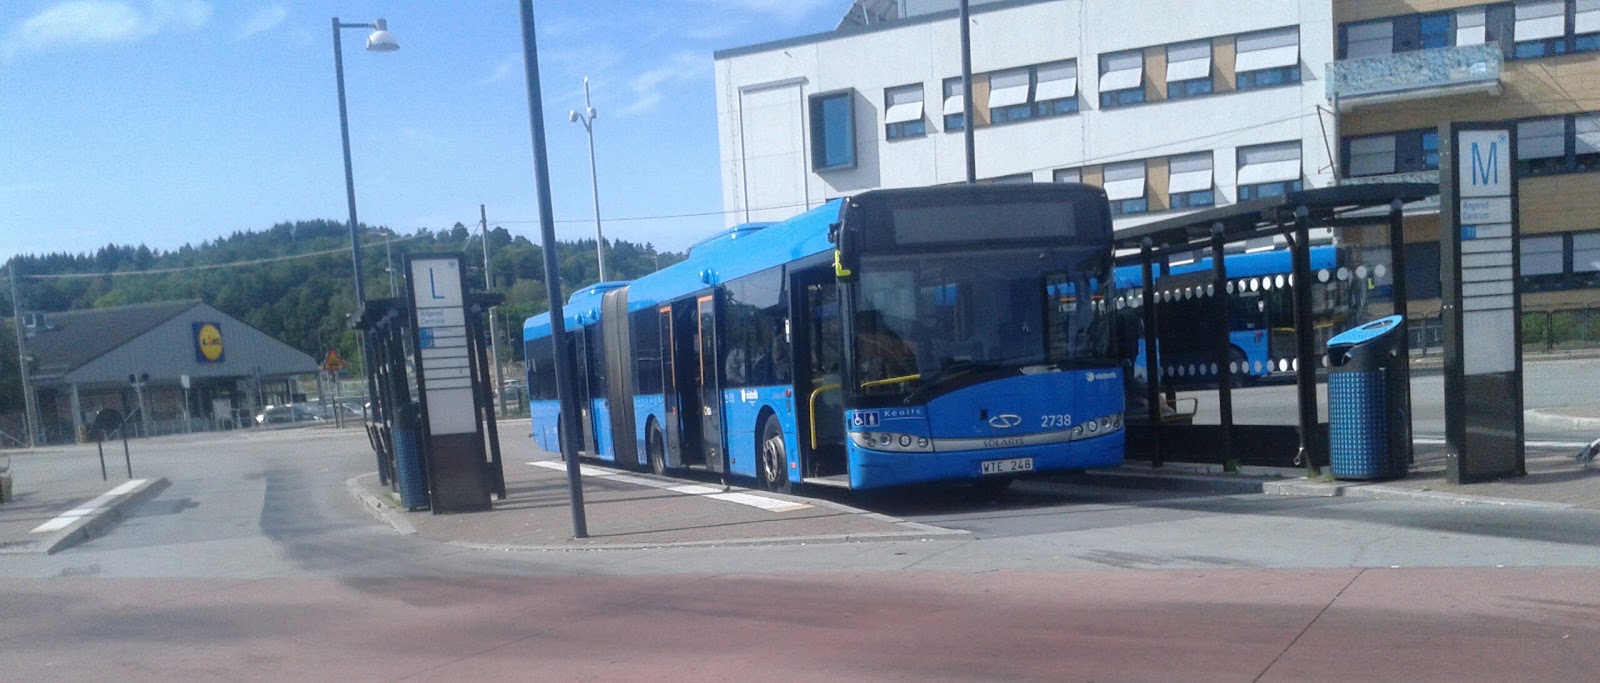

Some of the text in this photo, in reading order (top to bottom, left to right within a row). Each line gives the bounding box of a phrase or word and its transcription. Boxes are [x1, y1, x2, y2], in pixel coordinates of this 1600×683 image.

[1471, 141, 1498, 186] M
[429, 267, 445, 299] L
[1041, 414, 1072, 428] 2738
[983, 438, 1025, 448] SOLARIS
[983, 458, 1031, 472] WTE 248
